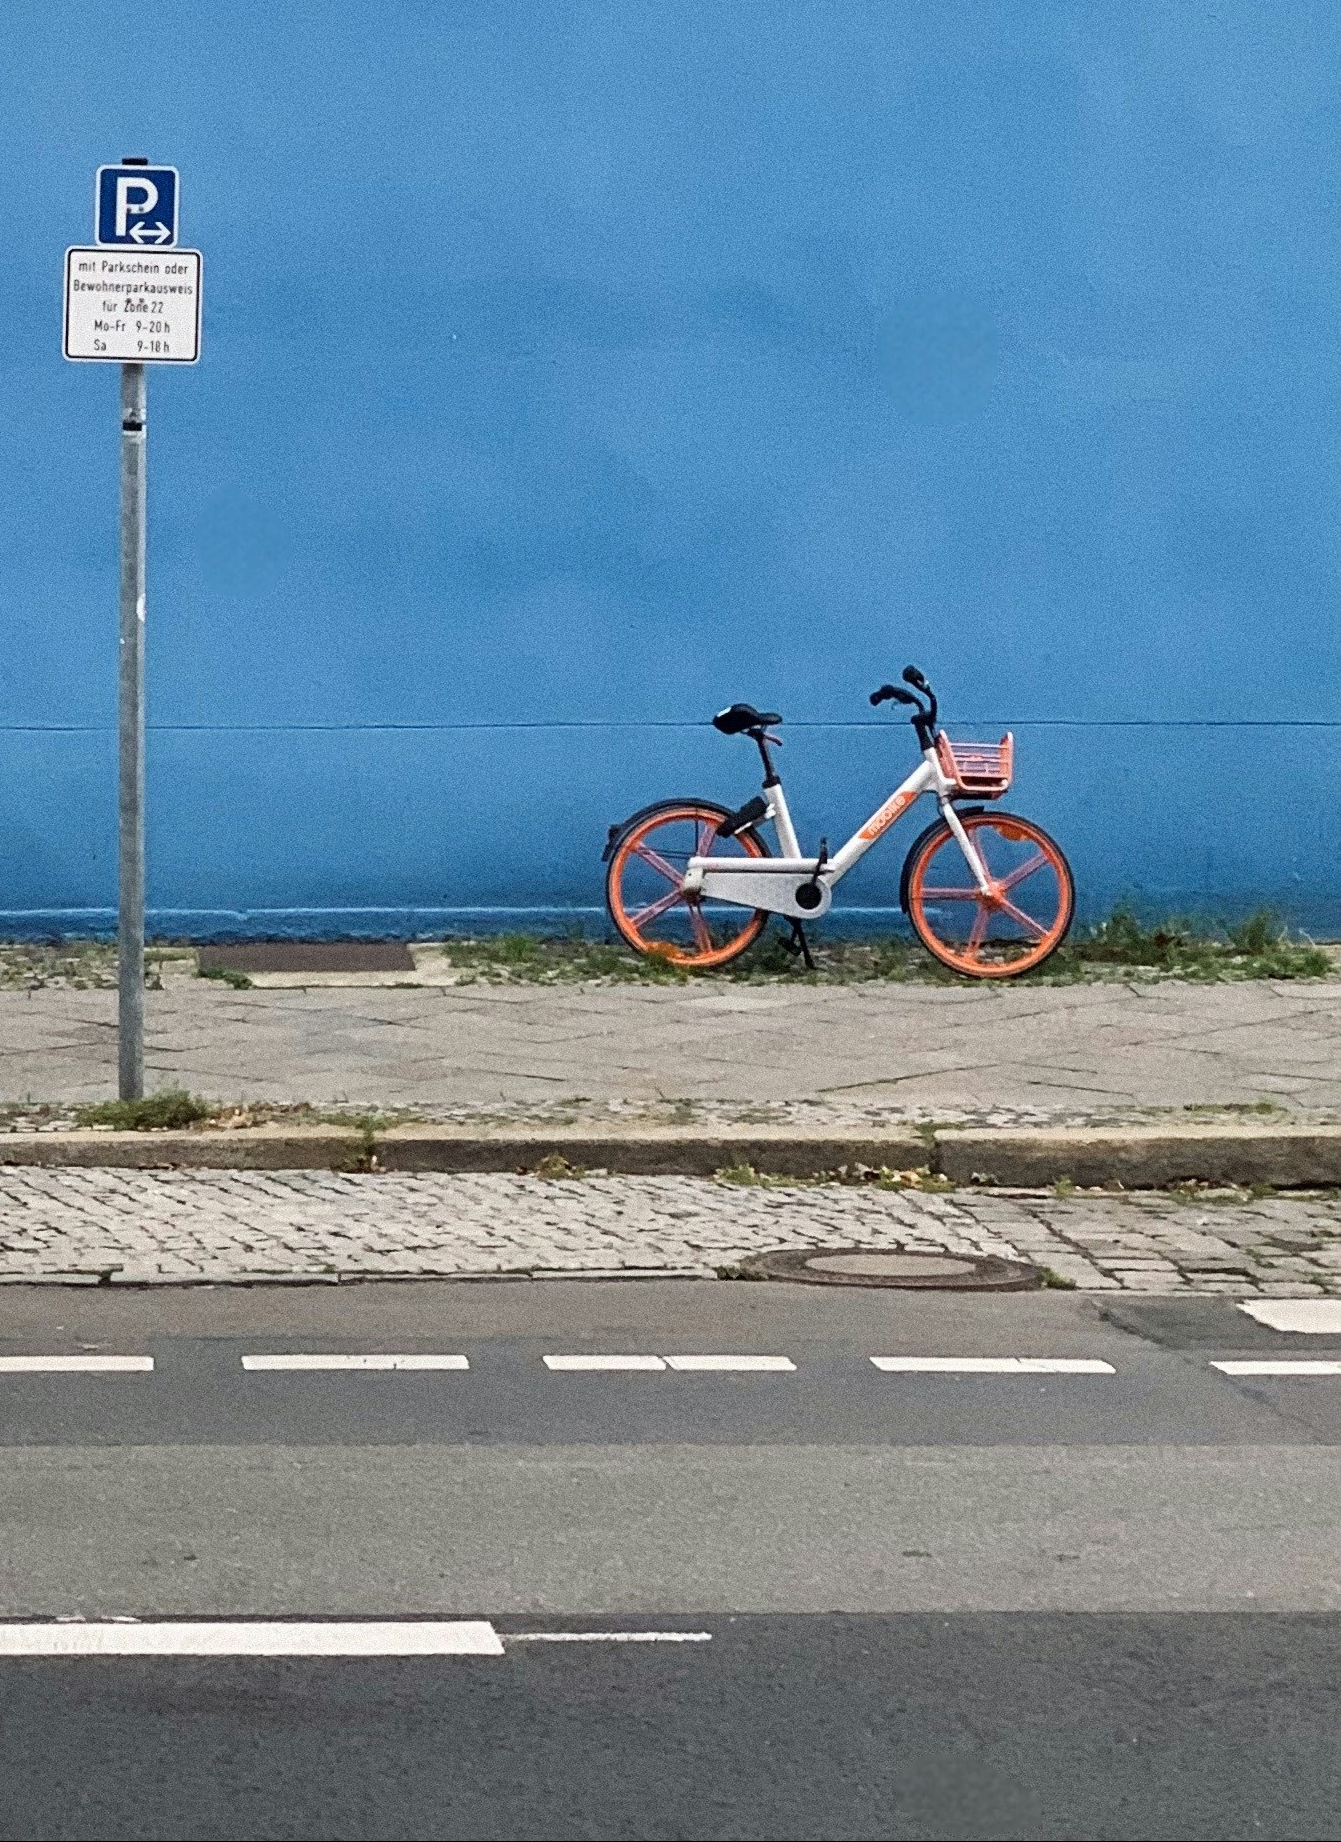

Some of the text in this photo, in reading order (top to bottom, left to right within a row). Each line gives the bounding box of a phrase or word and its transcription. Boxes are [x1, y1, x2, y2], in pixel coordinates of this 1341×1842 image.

[116, 177, 158, 236] P
[79, 261, 188, 275] mit Parkschein oder
[74, 280, 193, 295] Bewohnerparkausweis
[124, 301, 148, 313] Zone
[151, 302, 163, 313] 22
[95, 321, 126, 332] Mo-Fr
[94, 339, 107, 351] Sa
[867, 795, 906, 835] mobike
